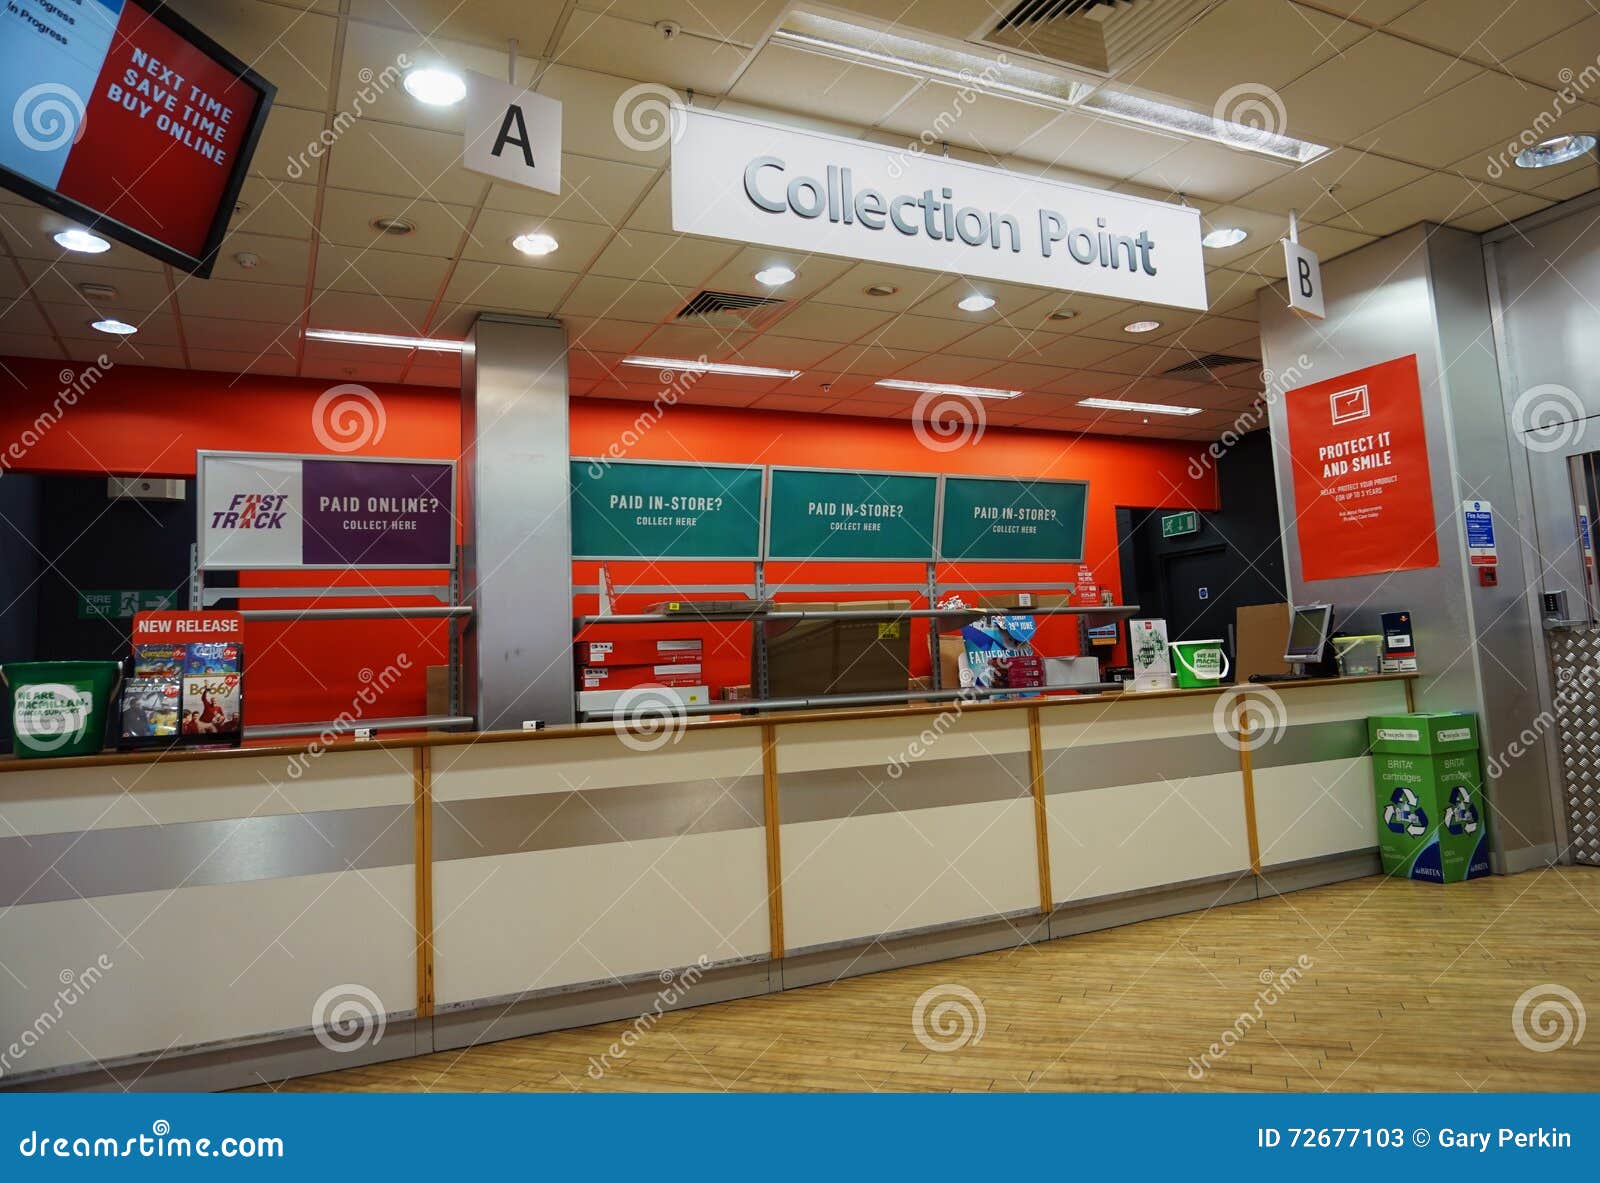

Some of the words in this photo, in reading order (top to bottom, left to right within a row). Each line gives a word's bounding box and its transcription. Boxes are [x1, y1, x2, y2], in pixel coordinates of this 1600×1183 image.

[7, 1, 18, 14] In
[20, 9, 68, 45] Progress
[132, 47, 185, 91] NEXT
[189, 85, 233, 124] TIME
[123, 68, 178, 112] SAVE
[183, 104, 226, 143] TIME
[107, 83, 152, 119] BUY
[156, 114, 226, 165] ONLINE
[490, 103, 535, 168] A
[743, 155, 1021, 253] Collection
[1039, 208, 1157, 276] Point
[1297, 256, 1313, 298] B
[1319, 435, 1374, 461] PROTECT
[1378, 431, 1391, 448] IT
[1323, 461, 1348, 478] AND
[1352, 450, 1392, 472] SMILE
[1366, 487, 1383, 496] YEARS
[229, 494, 289, 511] FAST
[319, 496, 360, 513] PAID
[367, 497, 439, 513] ONLINE?
[610, 494, 643, 509] PAID
[649, 495, 723, 511] IN-STORE?
[808, 502, 836, 516] PAID
[841, 503, 904, 518] IN-STORE?
[211, 512, 288, 529] TRACK
[636, 516, 672, 526] COLLECT
[676, 517, 697, 526] HERE
[974, 506, 998, 519] PAID
[1002, 507, 1056, 521] IN-STORE?
[343, 520, 387, 530] COLLECT
[391, 520, 417, 530] HERE
[830, 522, 861, 531] COLLECT
[863, 523, 881, 531] HERE
[992, 525, 1020, 533] COLLECT
[1021, 526, 1037, 534] HERE
[86, 594, 112, 604] FIRE
[86, 605, 112, 614] EXIT
[138, 620, 171, 633] NEW
[175, 619, 239, 632] RELEASE
[33, 691, 55, 700] ARE
[1383, 773, 1422, 784] cartridges
[1421, 867, 1441, 877] BRITA
